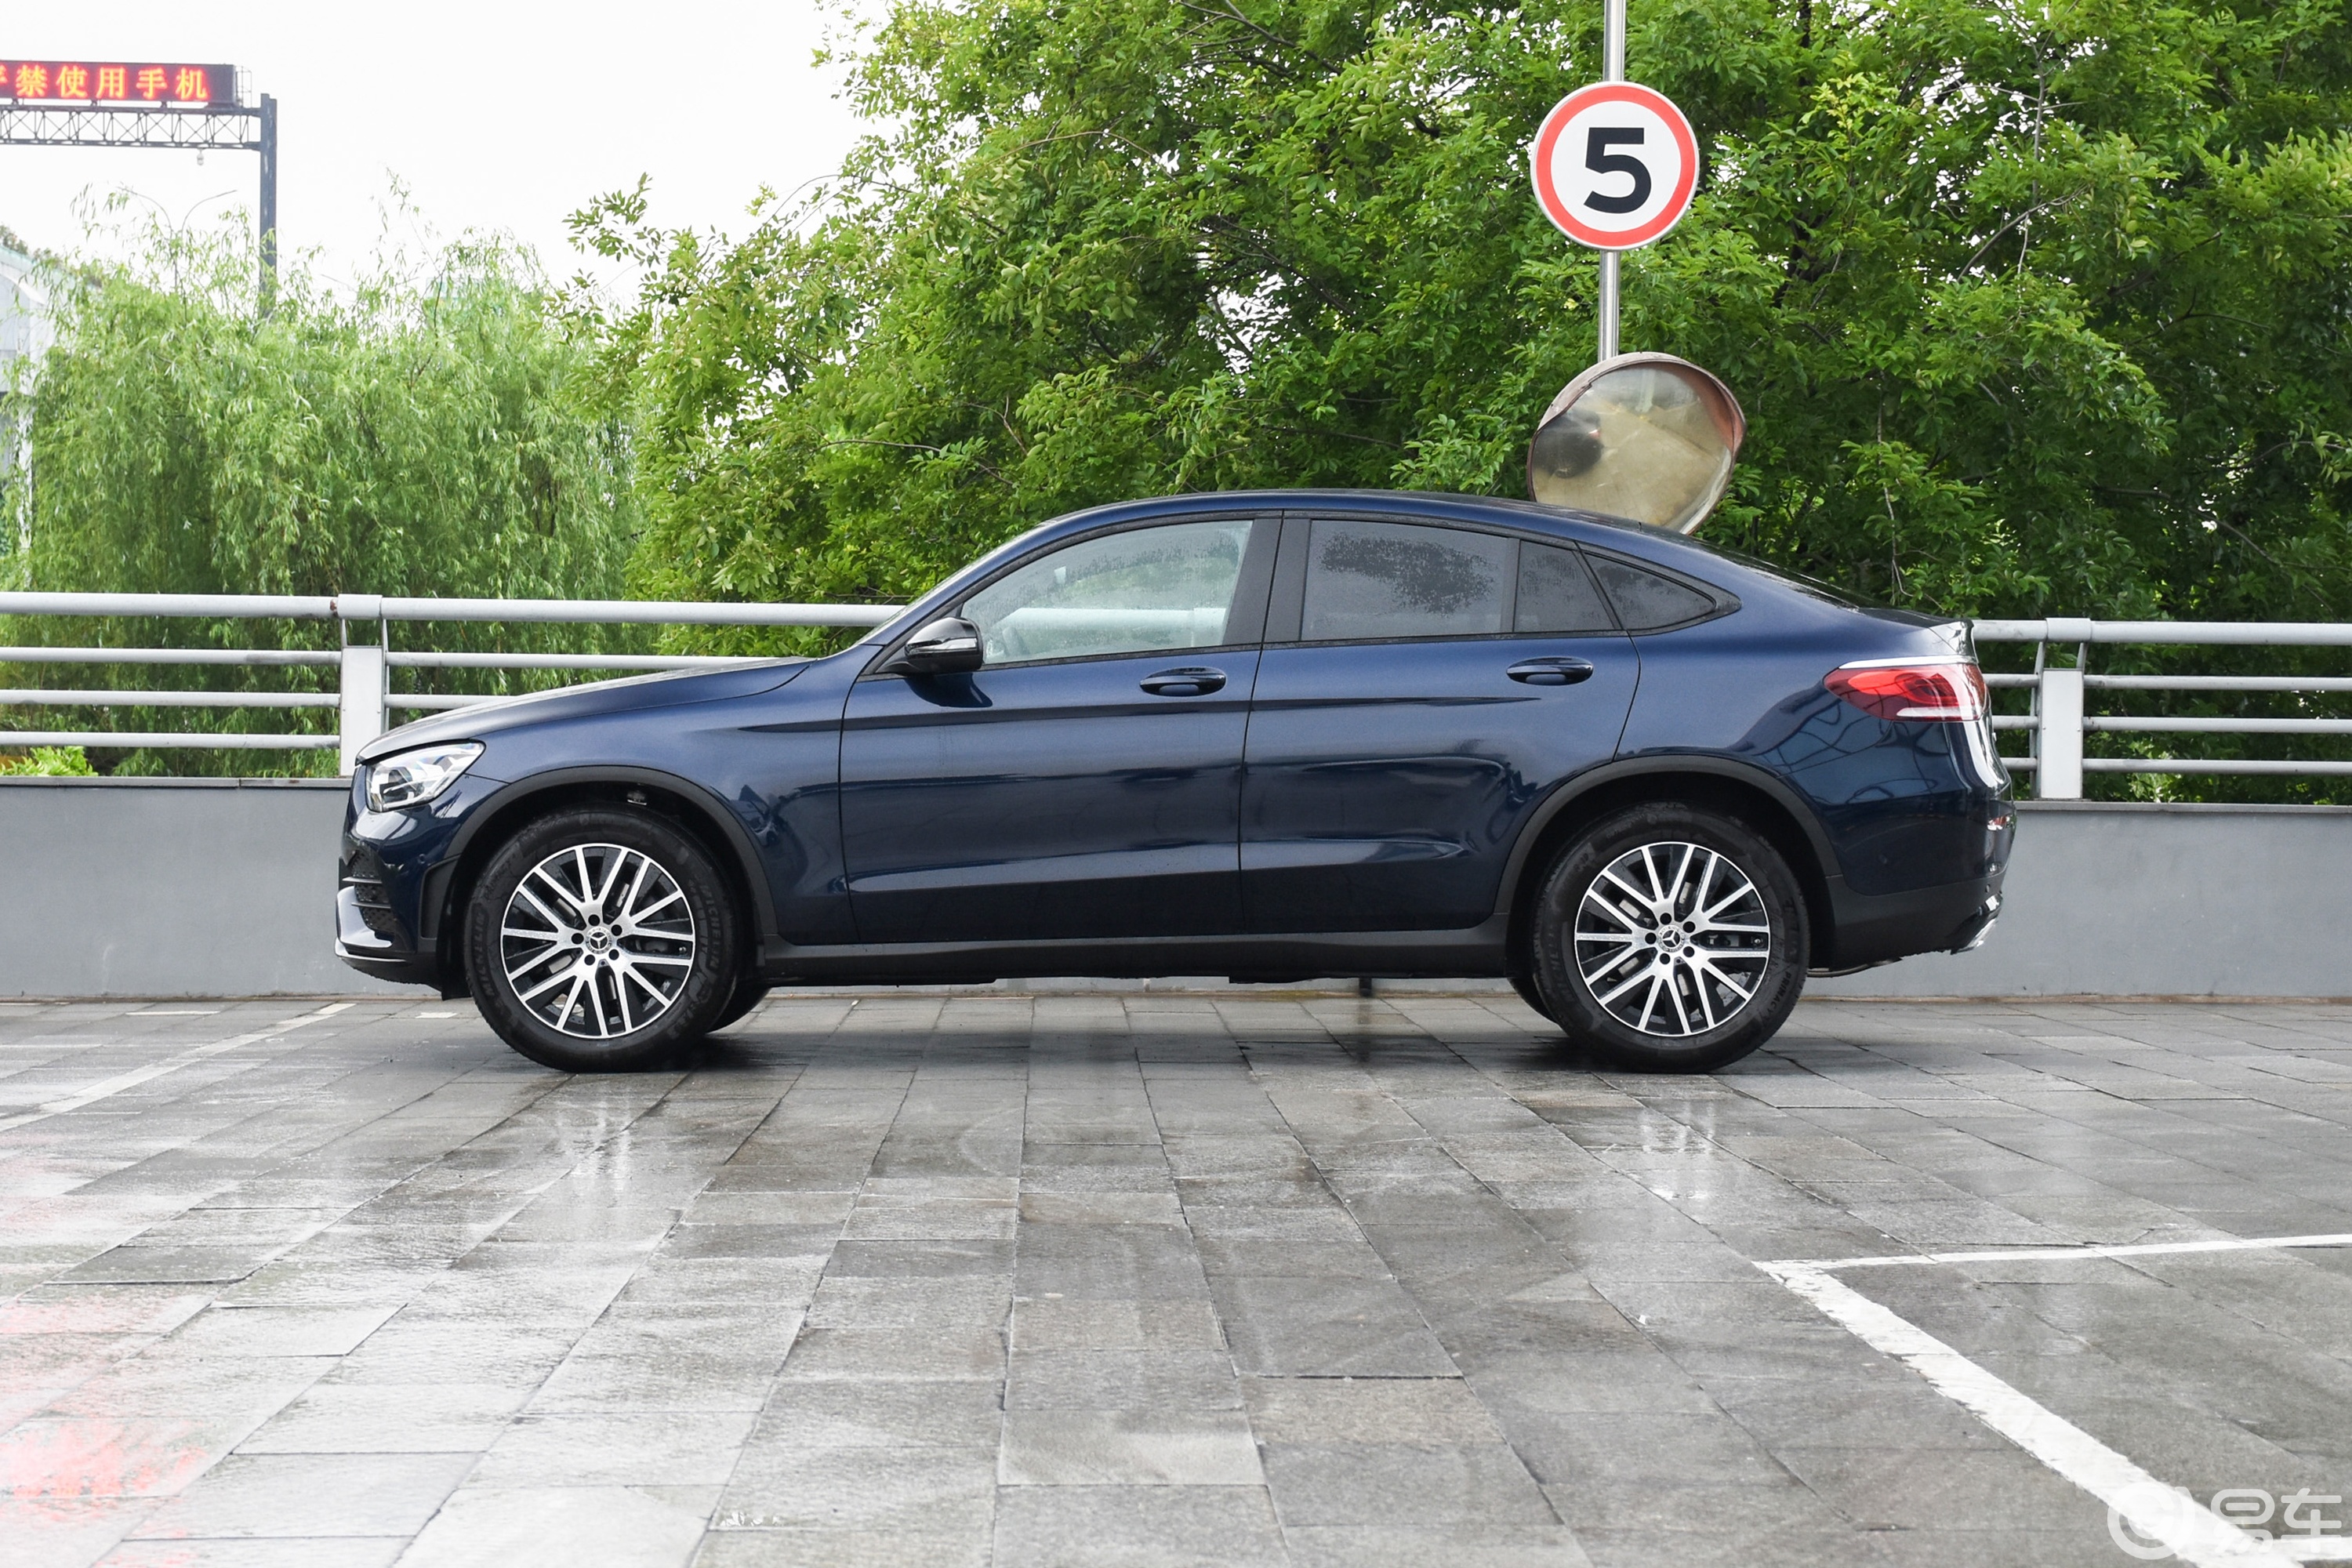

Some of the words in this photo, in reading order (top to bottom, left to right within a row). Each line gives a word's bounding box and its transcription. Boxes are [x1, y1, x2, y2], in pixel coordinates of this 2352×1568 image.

[0, 64, 209, 100] 禁使用手机
[1583, 127, 1652, 214] 5
